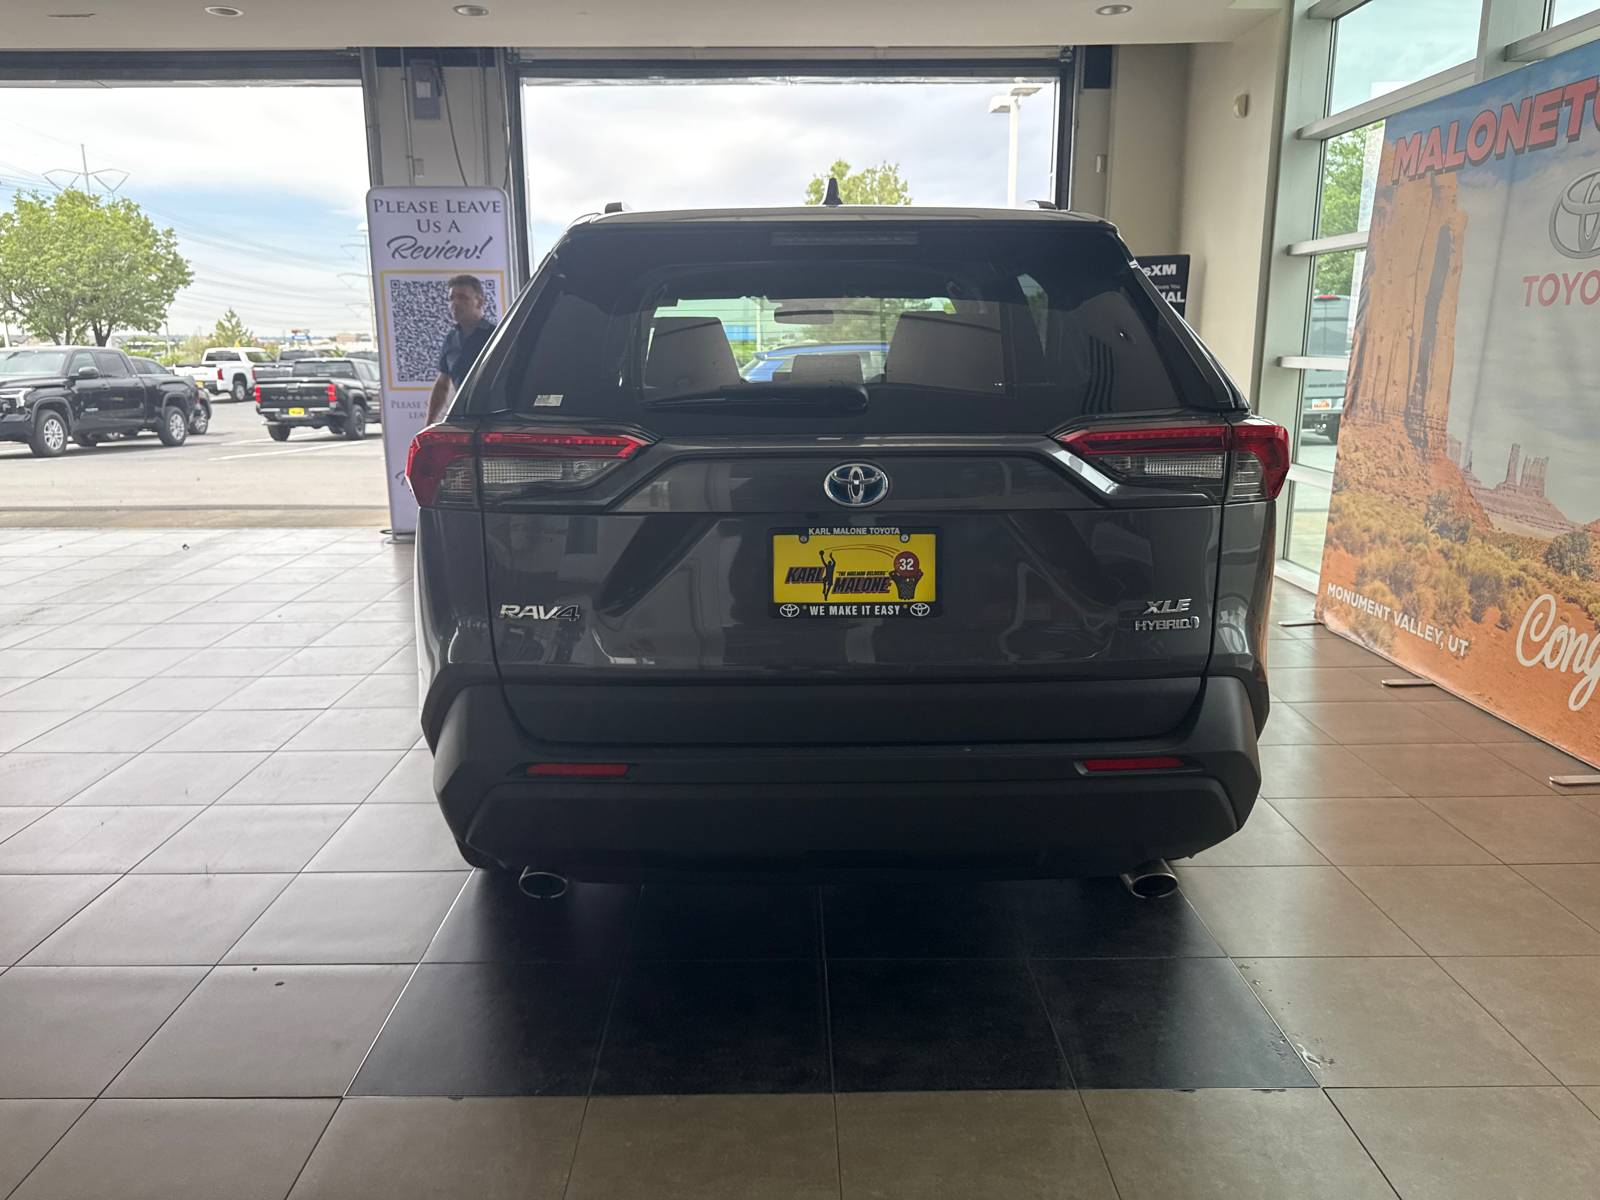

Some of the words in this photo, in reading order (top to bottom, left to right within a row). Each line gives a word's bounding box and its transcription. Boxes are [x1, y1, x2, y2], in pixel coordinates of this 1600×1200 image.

[1391, 75, 1600, 186] MALONET
[373, 198, 439, 214] PLEASE
[445, 198, 502, 214] LEAVE
[416, 218, 442, 234] US
[447, 219, 462, 234] A
[386, 235, 494, 260] Review!
[1522, 269, 1600, 307] TOYO
[390, 400, 421, 409] PLEASE
[808, 527, 831, 535] KARL
[832, 527, 868, 535] MALONE
[868, 526, 901, 535] TOYOTA
[899, 557, 914, 571] 32
[784, 566, 826, 584] KARL
[831, 576, 892, 594] MALONE
[499, 604, 580, 621] RAV4
[809, 605, 825, 616] WE
[829, 605, 858, 616] MAKE
[861, 605, 871, 615] IT
[874, 604, 900, 616] EASY
[1142, 598, 1192, 615] XLE
[1135, 618, 1189, 631] HYBRID
[1326, 582, 1391, 622] MONUMENT
[1393, 610, 1444, 650] VALLEY,
[1447, 634, 1469, 657] UT
